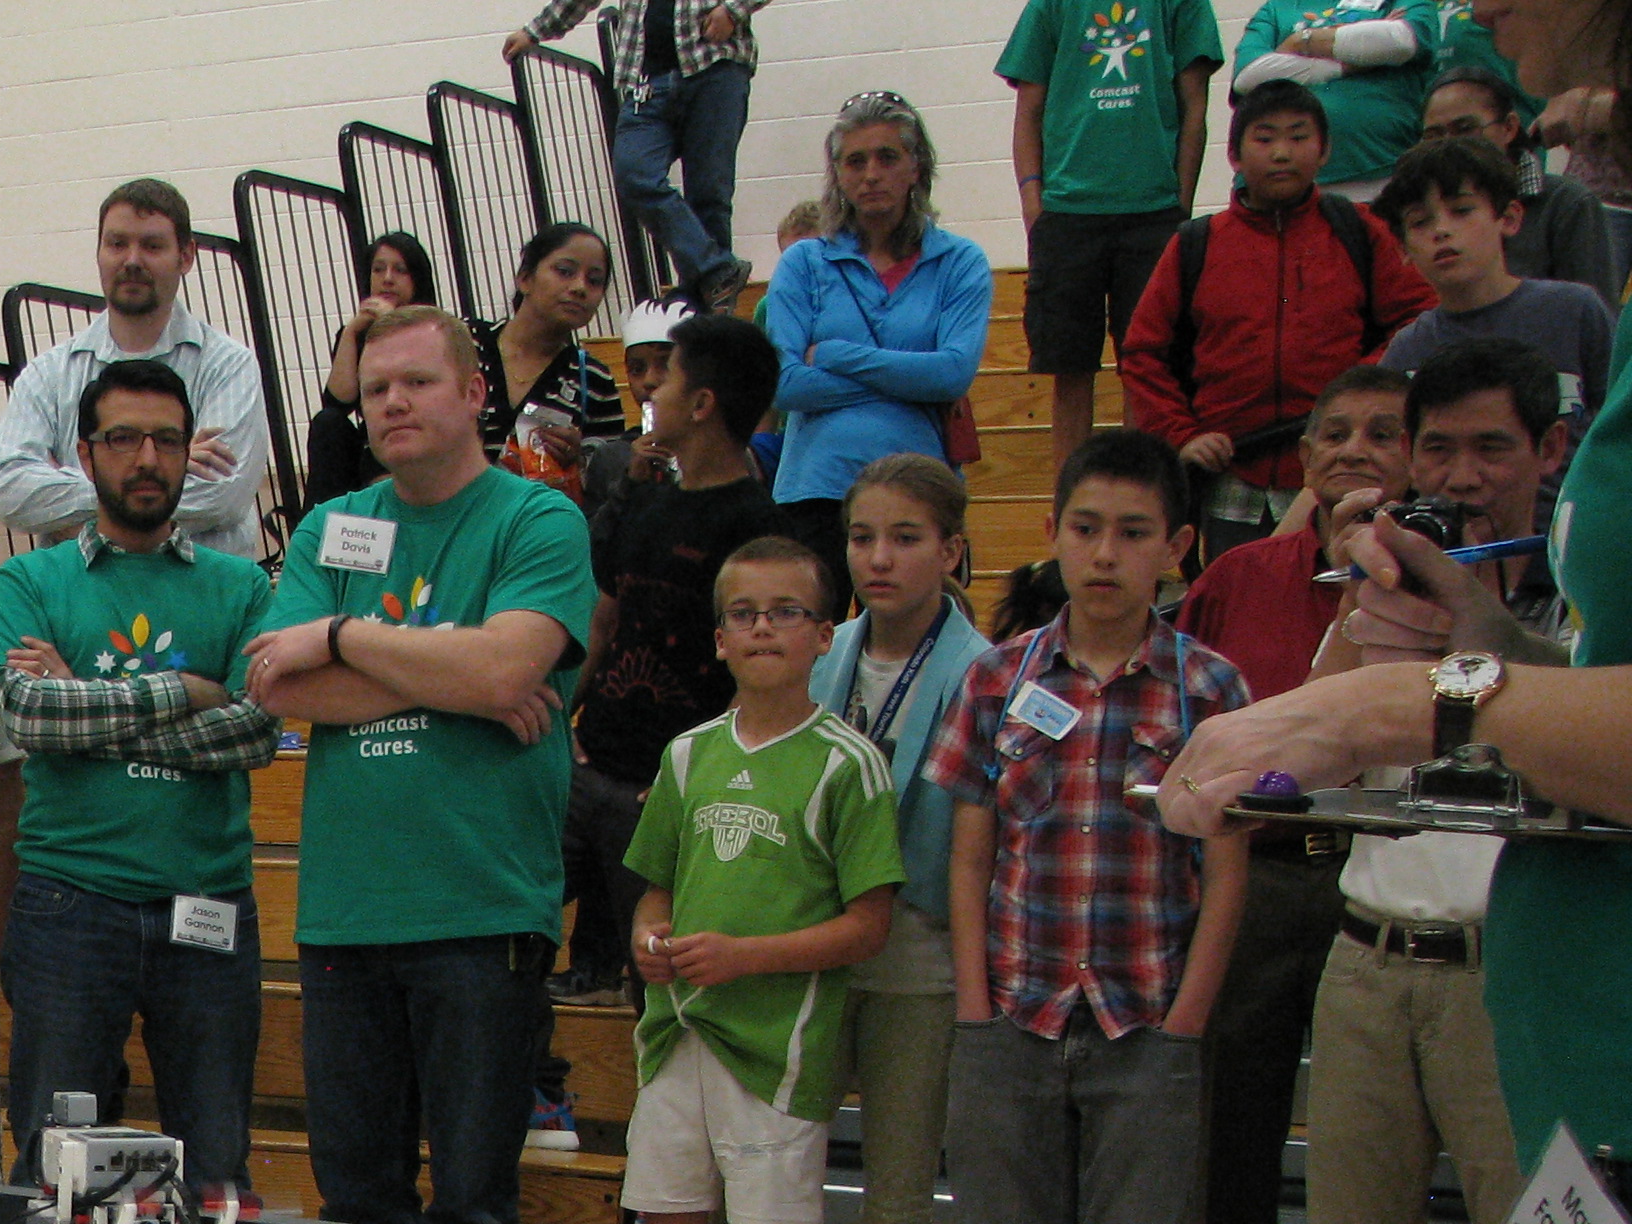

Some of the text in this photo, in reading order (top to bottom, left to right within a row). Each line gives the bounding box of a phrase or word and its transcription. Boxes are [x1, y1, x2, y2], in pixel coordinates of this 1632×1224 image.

[1089, 84, 1141, 99] Comcast
[341, 527, 377, 541] Patrick
[342, 541, 371, 554] Davis
[360, 739, 418, 758] Cares.
[693, 803, 786, 846] TREBOL
[191, 906, 220, 919] Jason
[185, 917, 225, 933] Gannon
